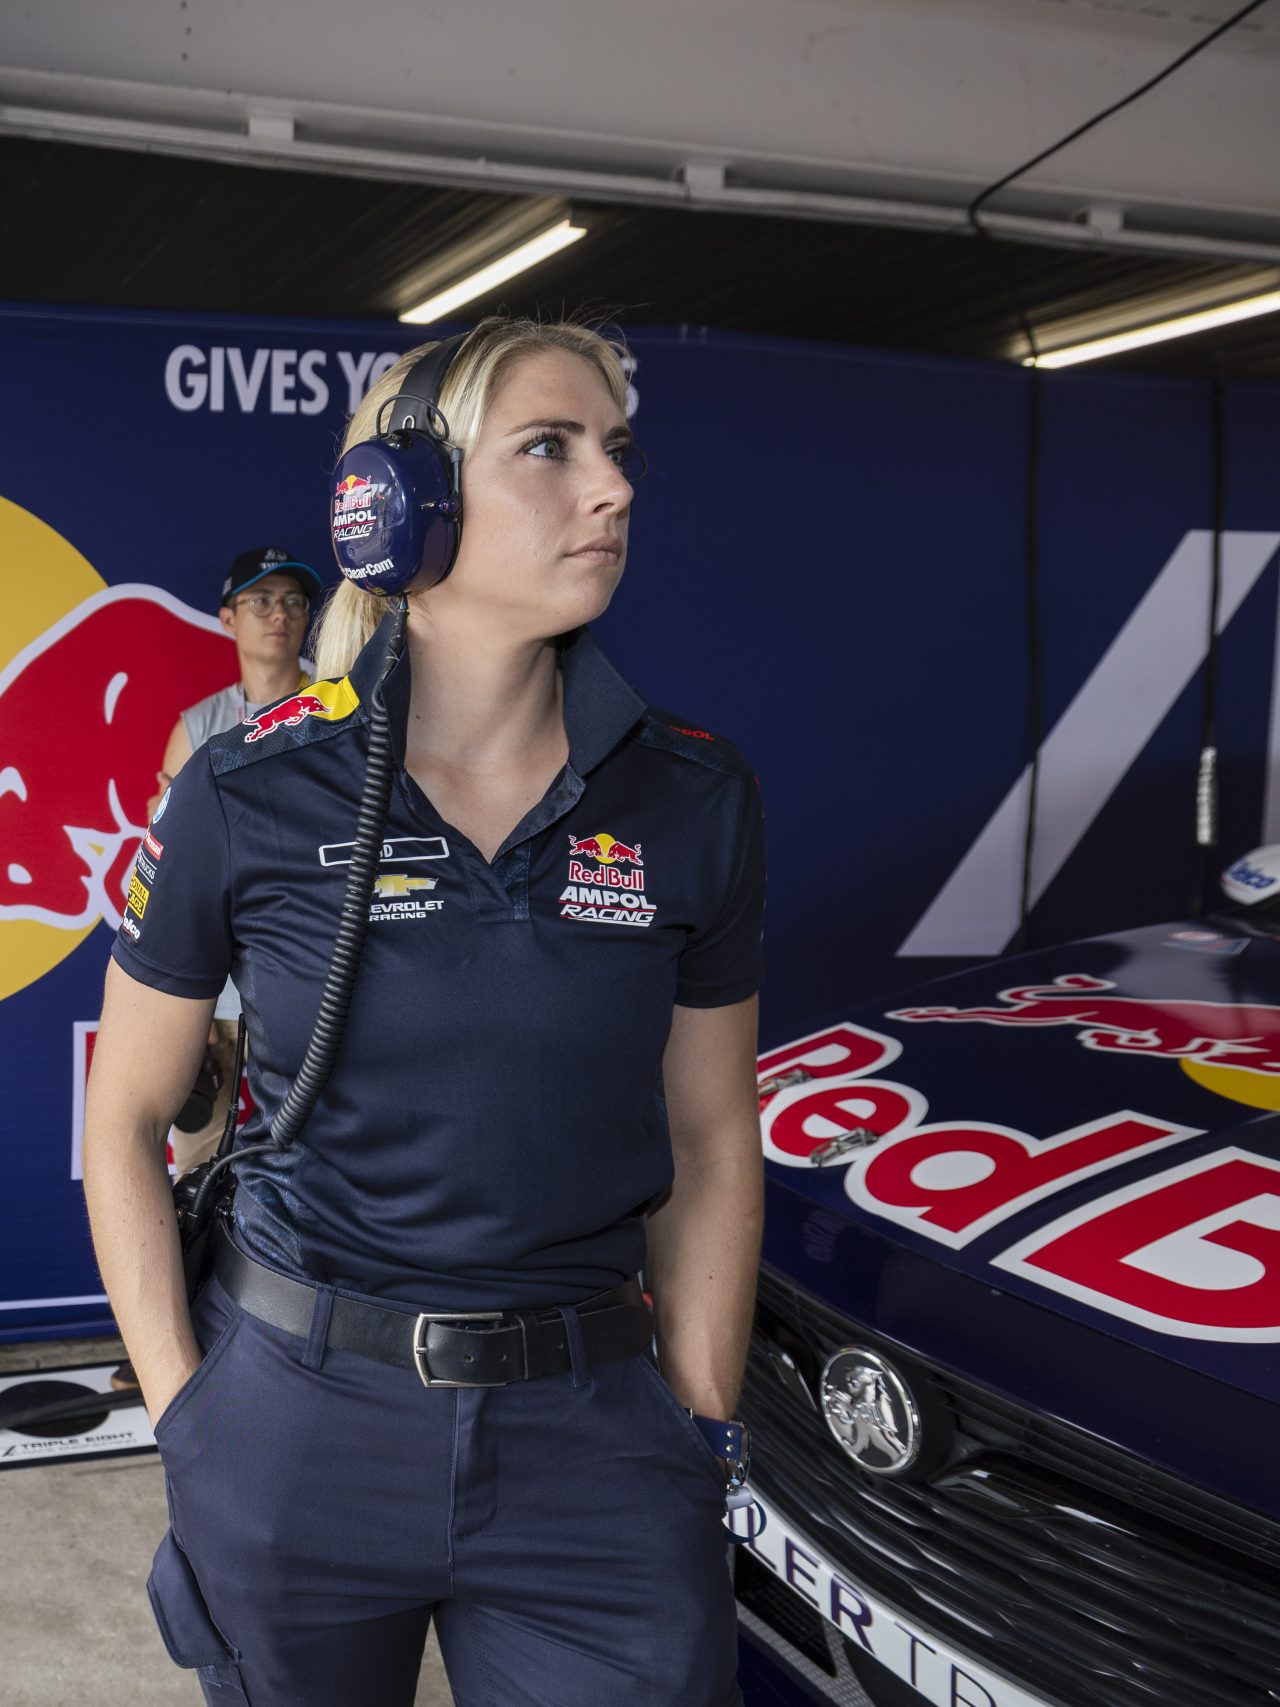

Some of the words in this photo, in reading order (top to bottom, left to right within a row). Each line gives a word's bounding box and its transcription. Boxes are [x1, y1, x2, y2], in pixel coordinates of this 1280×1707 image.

[164, 344, 329, 416] GIVES
[334, 499, 349, 514] Red
[349, 492, 372, 510] Bull
[333, 509, 377, 528] AMPOL
[333, 522, 375, 539] RACING
[568, 860, 606, 886] Red
[606, 866, 644, 891] Bull
[370, 900, 445, 914] EVROLET
[559, 885, 657, 910] AMPOL
[369, 911, 427, 922] RACING
[560, 903, 655, 923] RACING
[21, 1438, 81, 1450] TRIPLE
[85, 1431, 134, 1443] EIGHT
